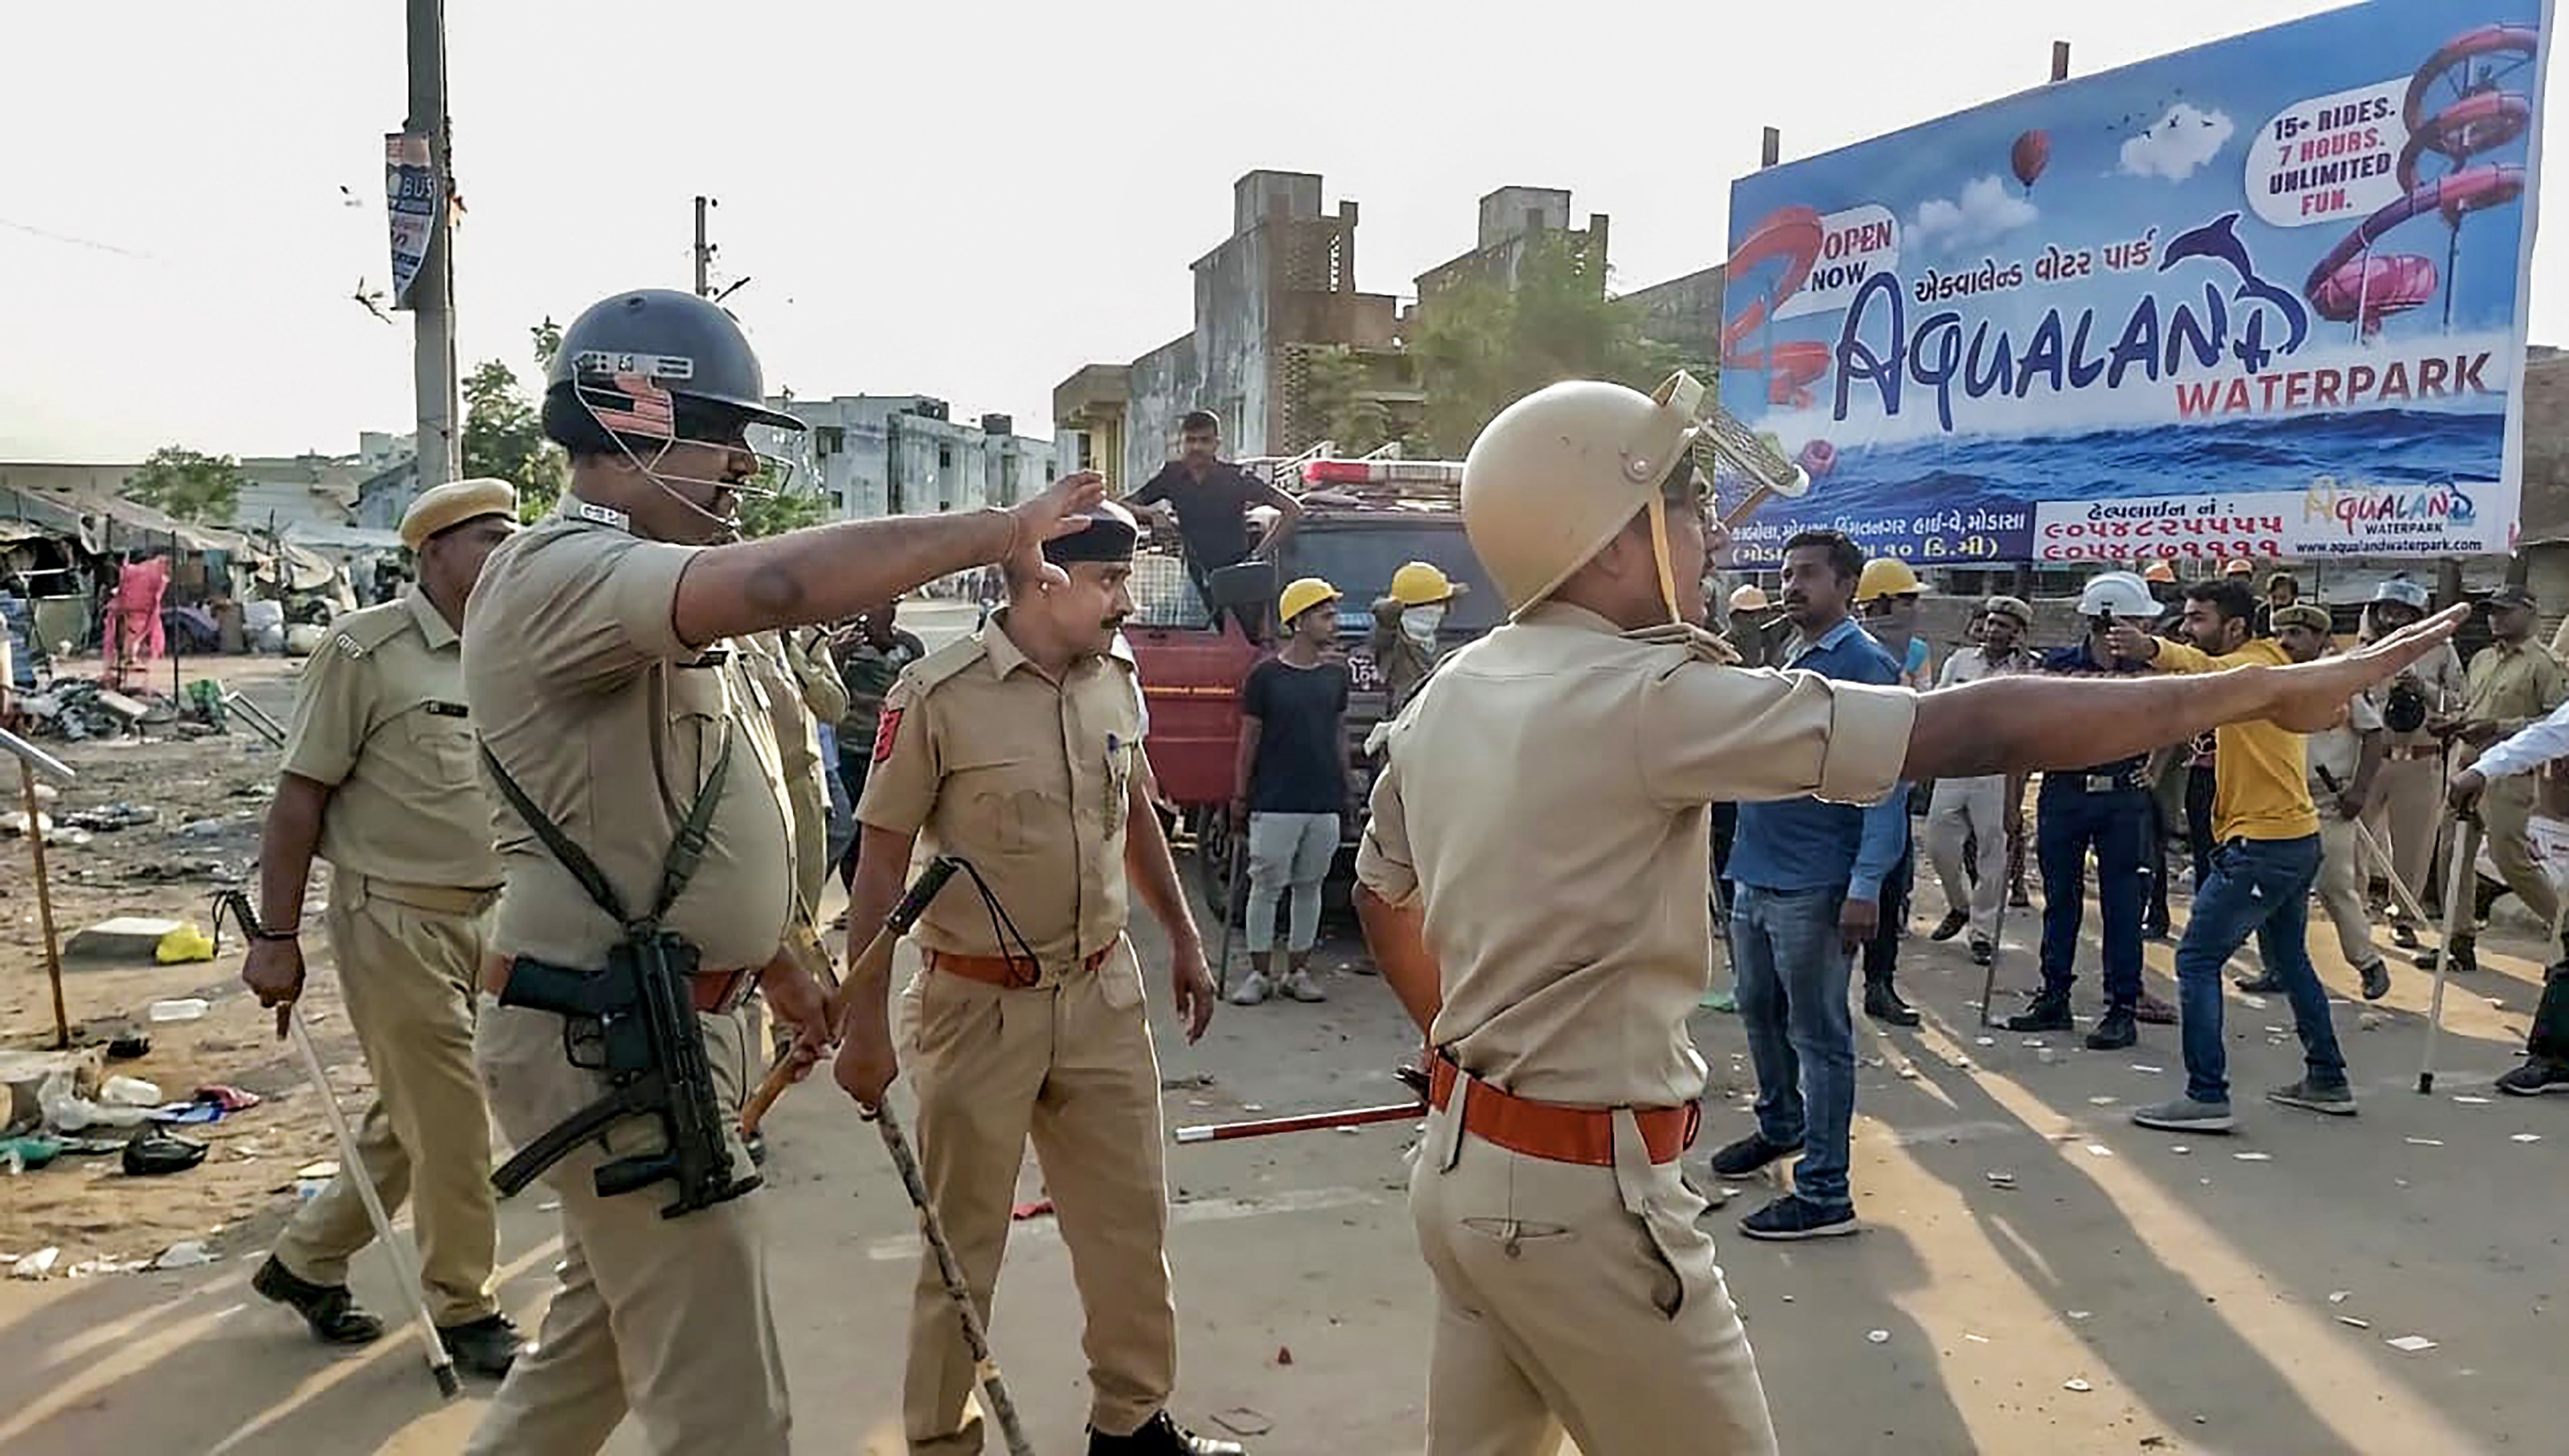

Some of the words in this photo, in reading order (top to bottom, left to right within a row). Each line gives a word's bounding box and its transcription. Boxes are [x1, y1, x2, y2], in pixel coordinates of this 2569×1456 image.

[2318, 97, 2395, 131] RIDES.
[2279, 145, 2292, 166] 7
[2300, 127, 2385, 162] HOURS.
[2269, 153, 2391, 194] UNLIMITED
[2302, 188, 2352, 216] FUN.
[1824, 219, 1892, 260] OPEN
[2035, 246, 2091, 281] વોટર
[2104, 227, 2156, 269] પાર્ક
[1812, 261, 1867, 291] NOW
[1834, 272, 2308, 431] AQUALAND
[2176, 353, 2491, 420] WATERPARK
[2366, 523, 2443, 534] WATERPARK
